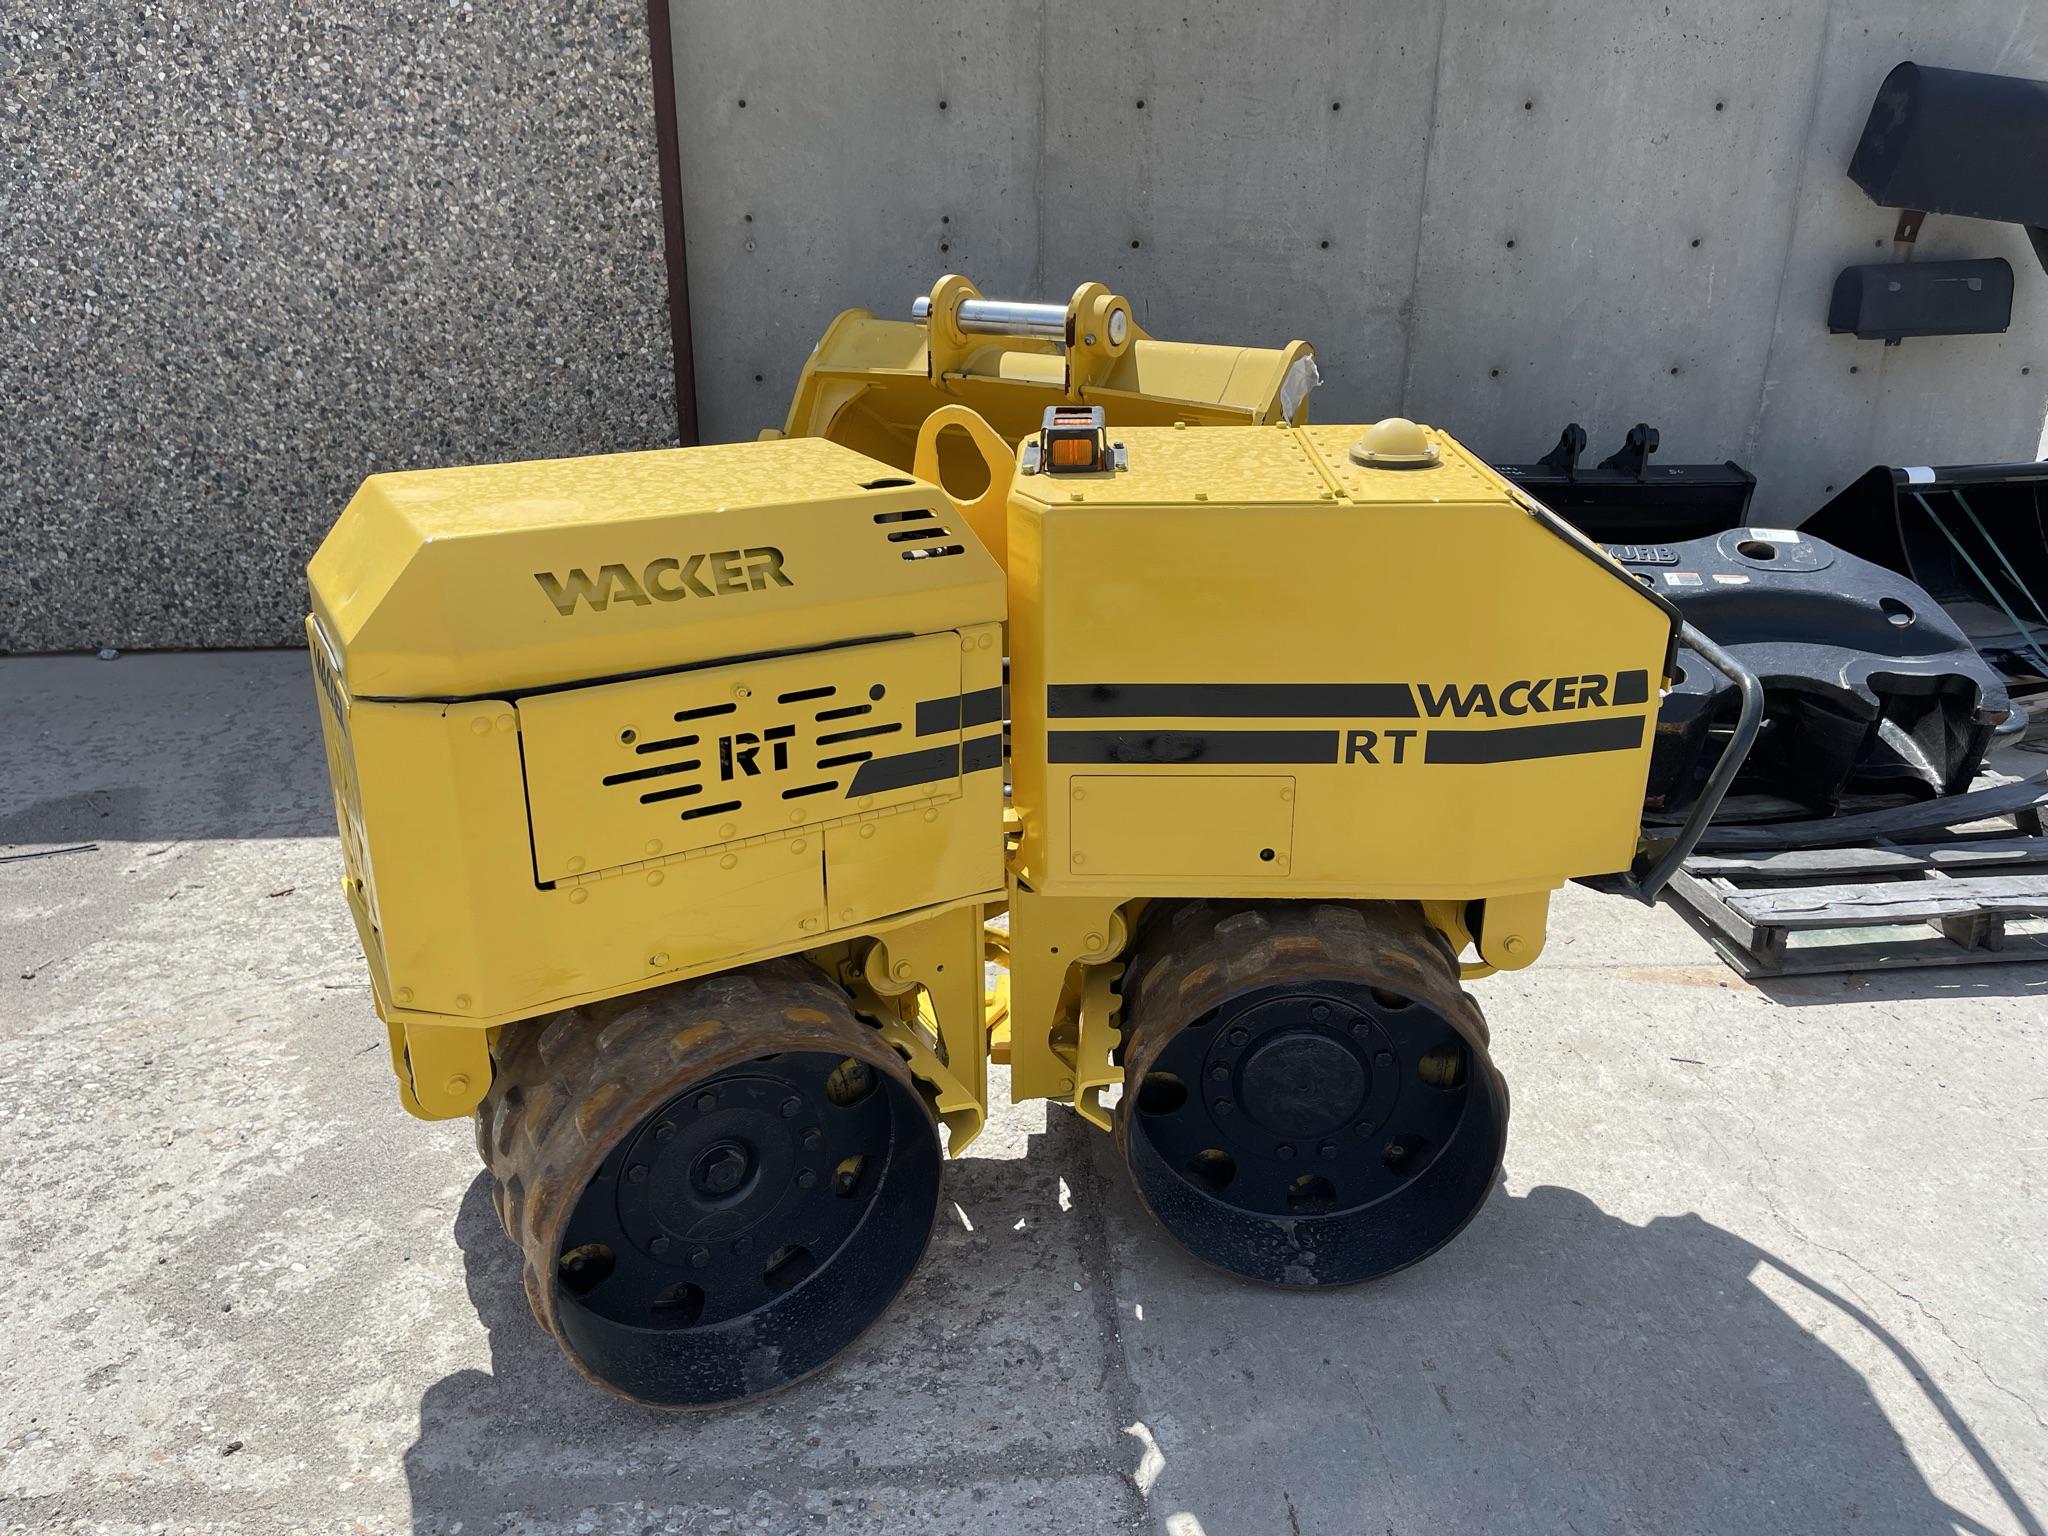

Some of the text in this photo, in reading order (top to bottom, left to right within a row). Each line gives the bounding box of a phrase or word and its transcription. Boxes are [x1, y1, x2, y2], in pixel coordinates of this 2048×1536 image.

[1617, 546, 1676, 561] JRB
[534, 546, 794, 616] WACKER
[1417, 674, 1609, 718] WACKER
[719, 724, 796, 781] RT
[1345, 730, 1418, 764] RT
